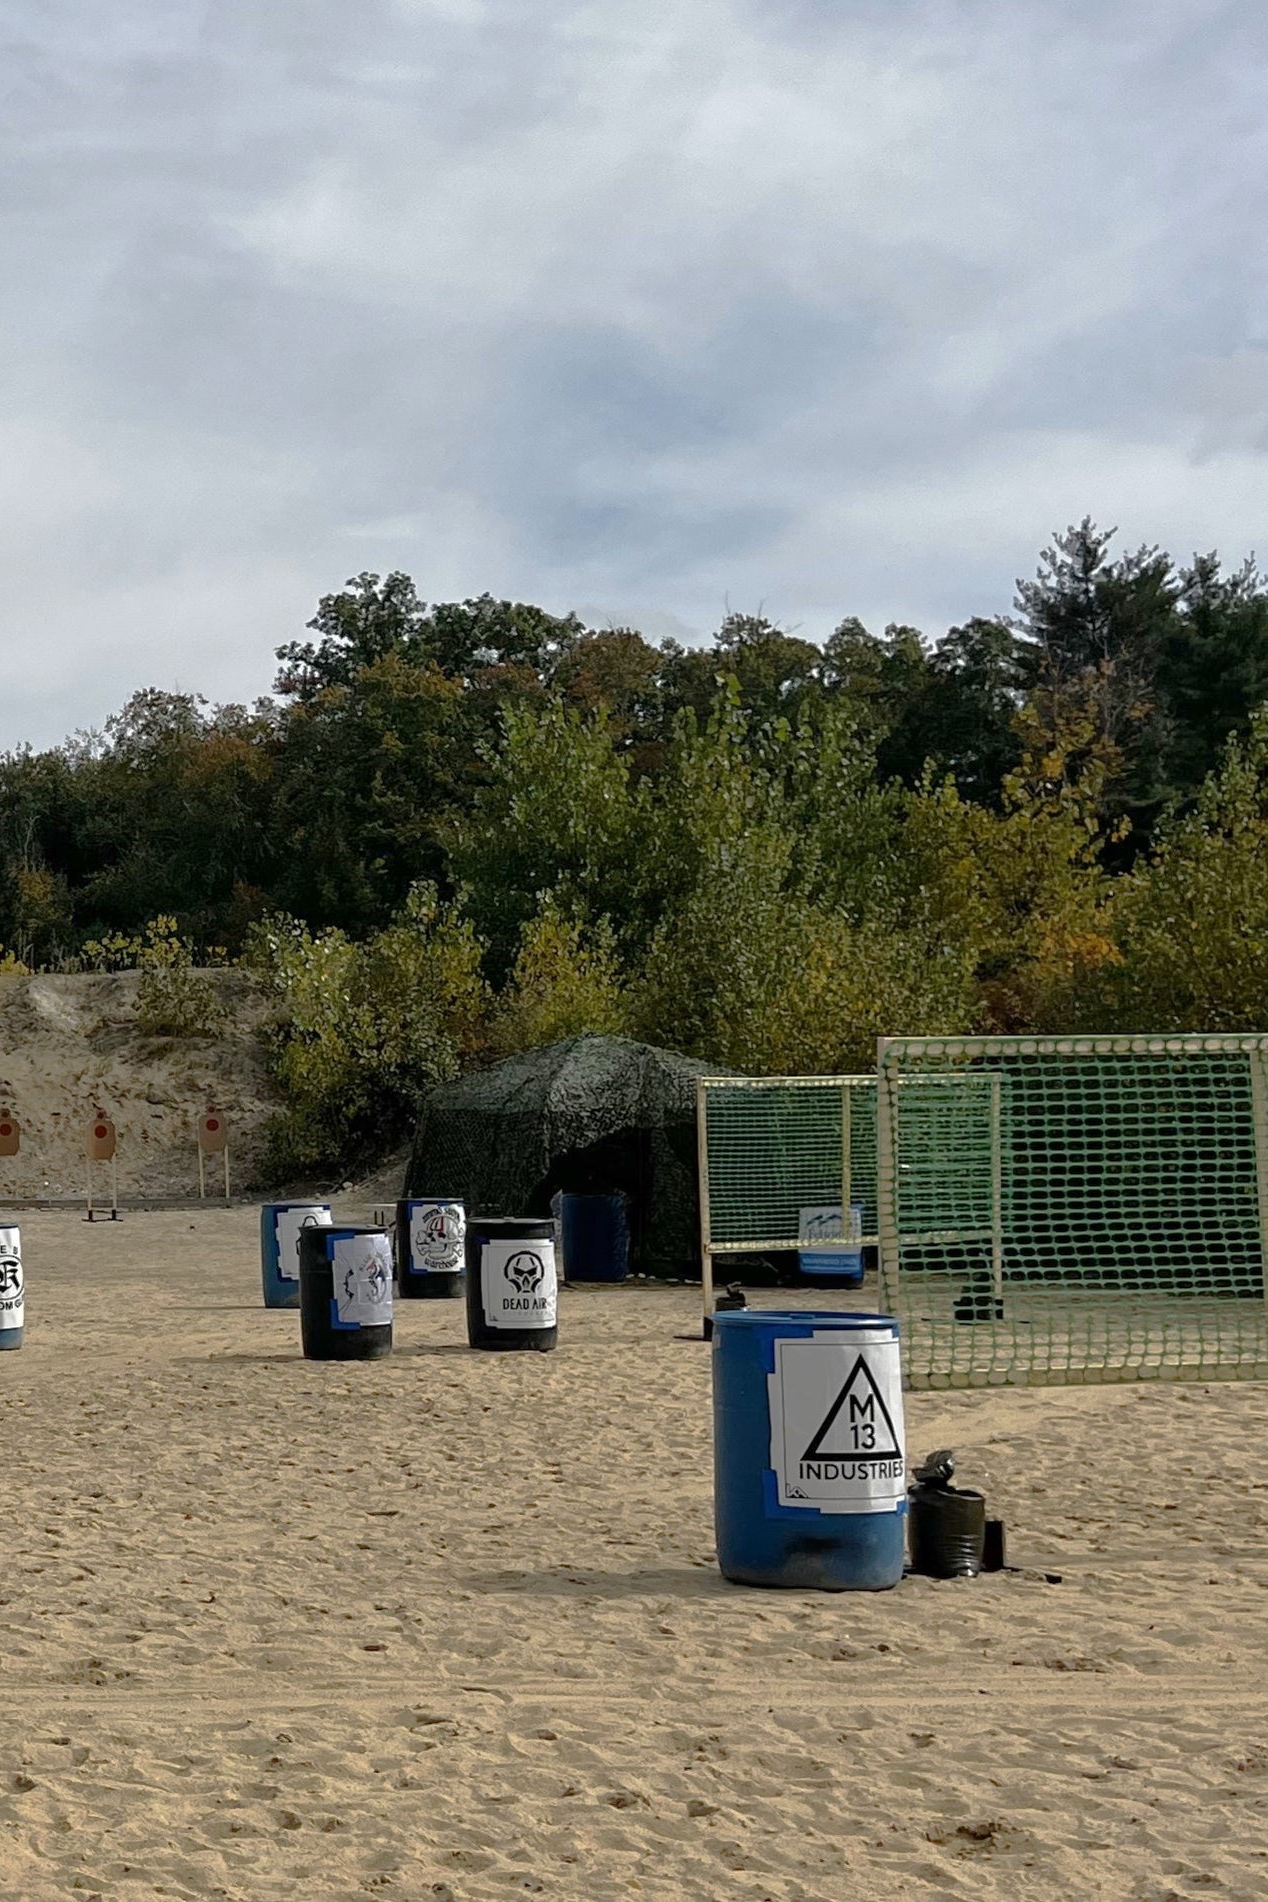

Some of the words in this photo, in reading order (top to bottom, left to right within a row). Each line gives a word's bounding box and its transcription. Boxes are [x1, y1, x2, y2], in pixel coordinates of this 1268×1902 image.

[503, 1298, 530, 1310] DEAD
[531, 1297, 547, 1310] AIR
[849, 1394, 875, 1423] M
[850, 1424, 876, 1450] 13
[799, 1460, 904, 1480] INDUSTRIES
